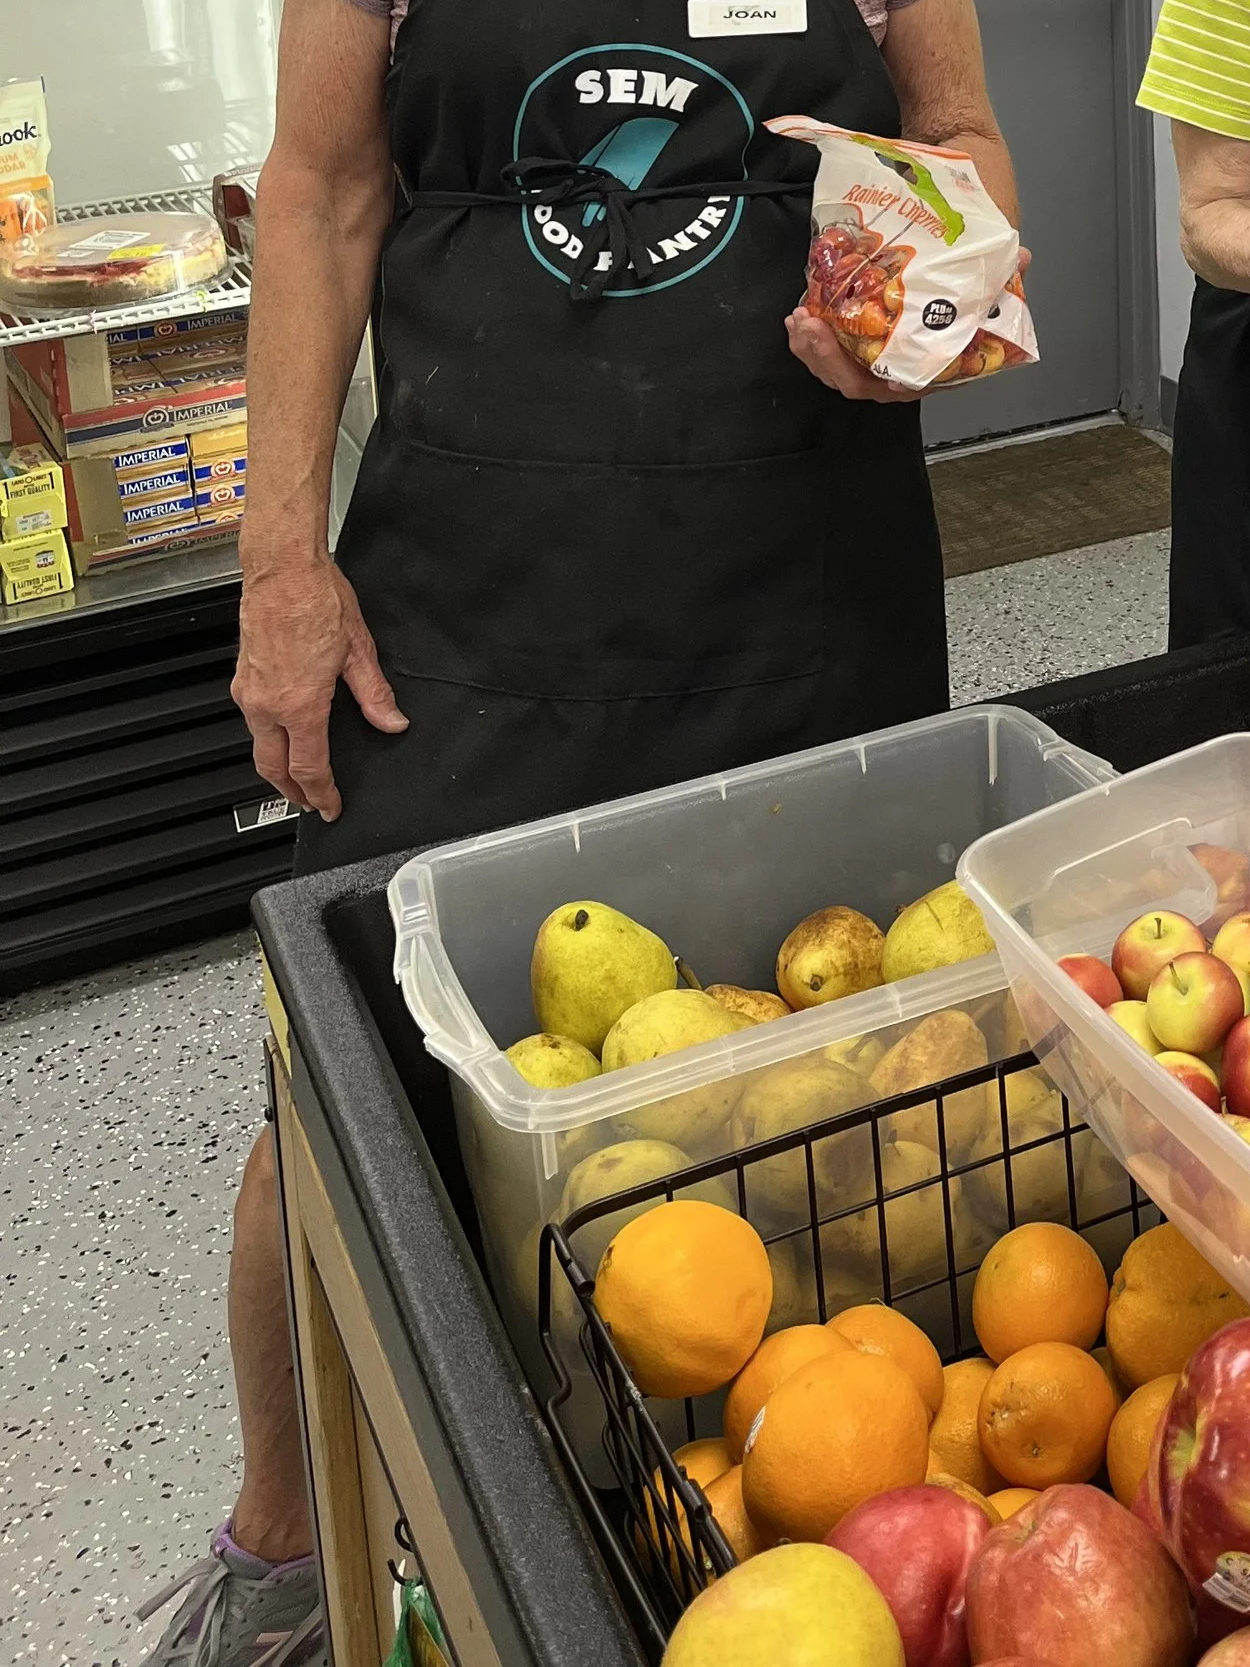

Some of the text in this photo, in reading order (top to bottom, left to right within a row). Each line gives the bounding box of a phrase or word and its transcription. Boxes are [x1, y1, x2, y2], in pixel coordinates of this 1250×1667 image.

[723, 9, 777, 20] JOAN
[575, 68, 699, 113] SEM
[842, 183, 952, 239] Rainier Cherries
[532, 192, 584, 259] OOD
[187, 313, 239, 331] IMPERIAL
[173, 401, 232, 422] IMPERIAL
[118, 447, 176, 467] IMPERIAL
[10, 483, 51, 499] FIRST QUALITY
[124, 474, 181, 495] IMPERIAL
[127, 501, 184, 522] IMPERIAL
